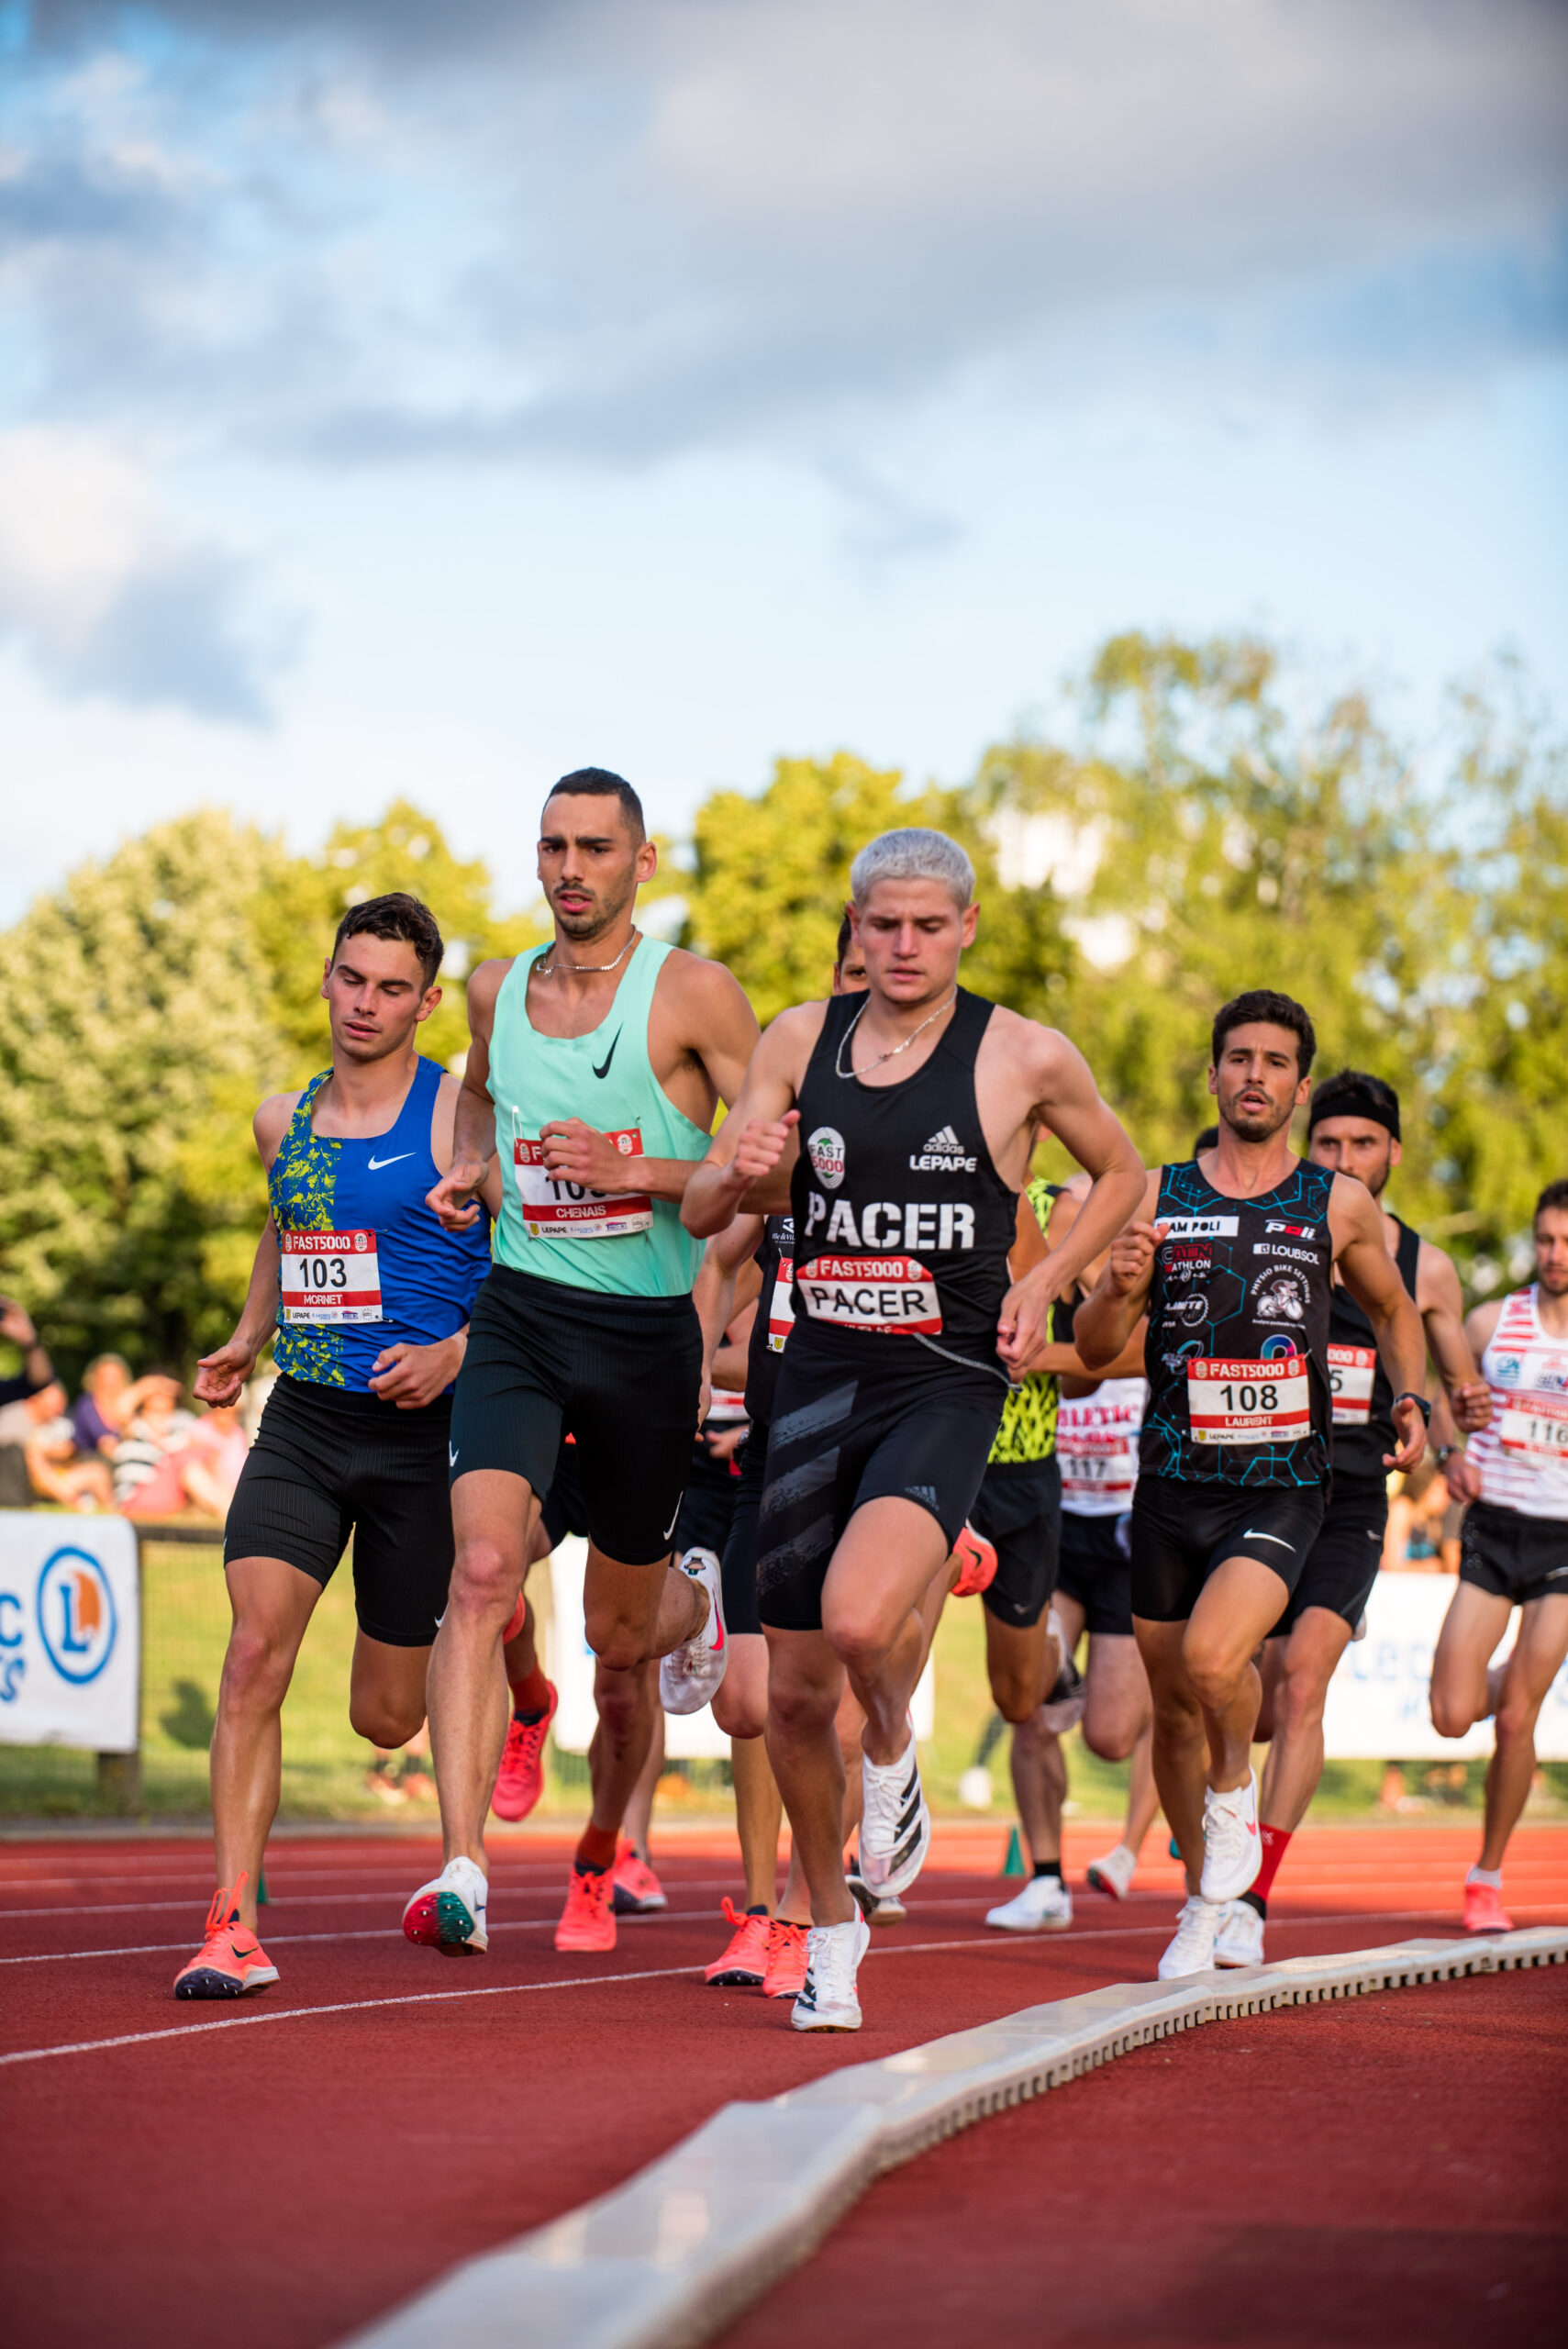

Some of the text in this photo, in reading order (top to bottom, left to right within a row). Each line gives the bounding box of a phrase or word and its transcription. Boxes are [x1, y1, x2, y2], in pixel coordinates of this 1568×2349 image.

[808, 1144, 844, 1159] FAST
[923, 1143, 965, 1154] adidas
[811, 1154, 844, 1173] 5000
[909, 1154, 977, 1173] LEPAPE
[545, 1175, 607, 1201] 10
[555, 1205, 606, 1219] CHENAIS
[804, 1190, 975, 1250] PACER
[293, 1235, 351, 1251] FAST5000
[1271, 1243, 1320, 1265] LOUBSOL
[299, 1258, 347, 1288] 103
[820, 1259, 904, 1277] FAST5000
[1273, 1264, 1293, 1273] BIKE
[304, 1294, 342, 1305] MORNET
[809, 1286, 929, 1317] PACER
[292, 1311, 310, 1319] LEPAPE
[1209, 1363, 1284, 1378] FAST5000
[1220, 1385, 1278, 1411] 108
[1225, 1416, 1273, 1427] LAURENT
[1068, 1458, 1106, 1478] 117
